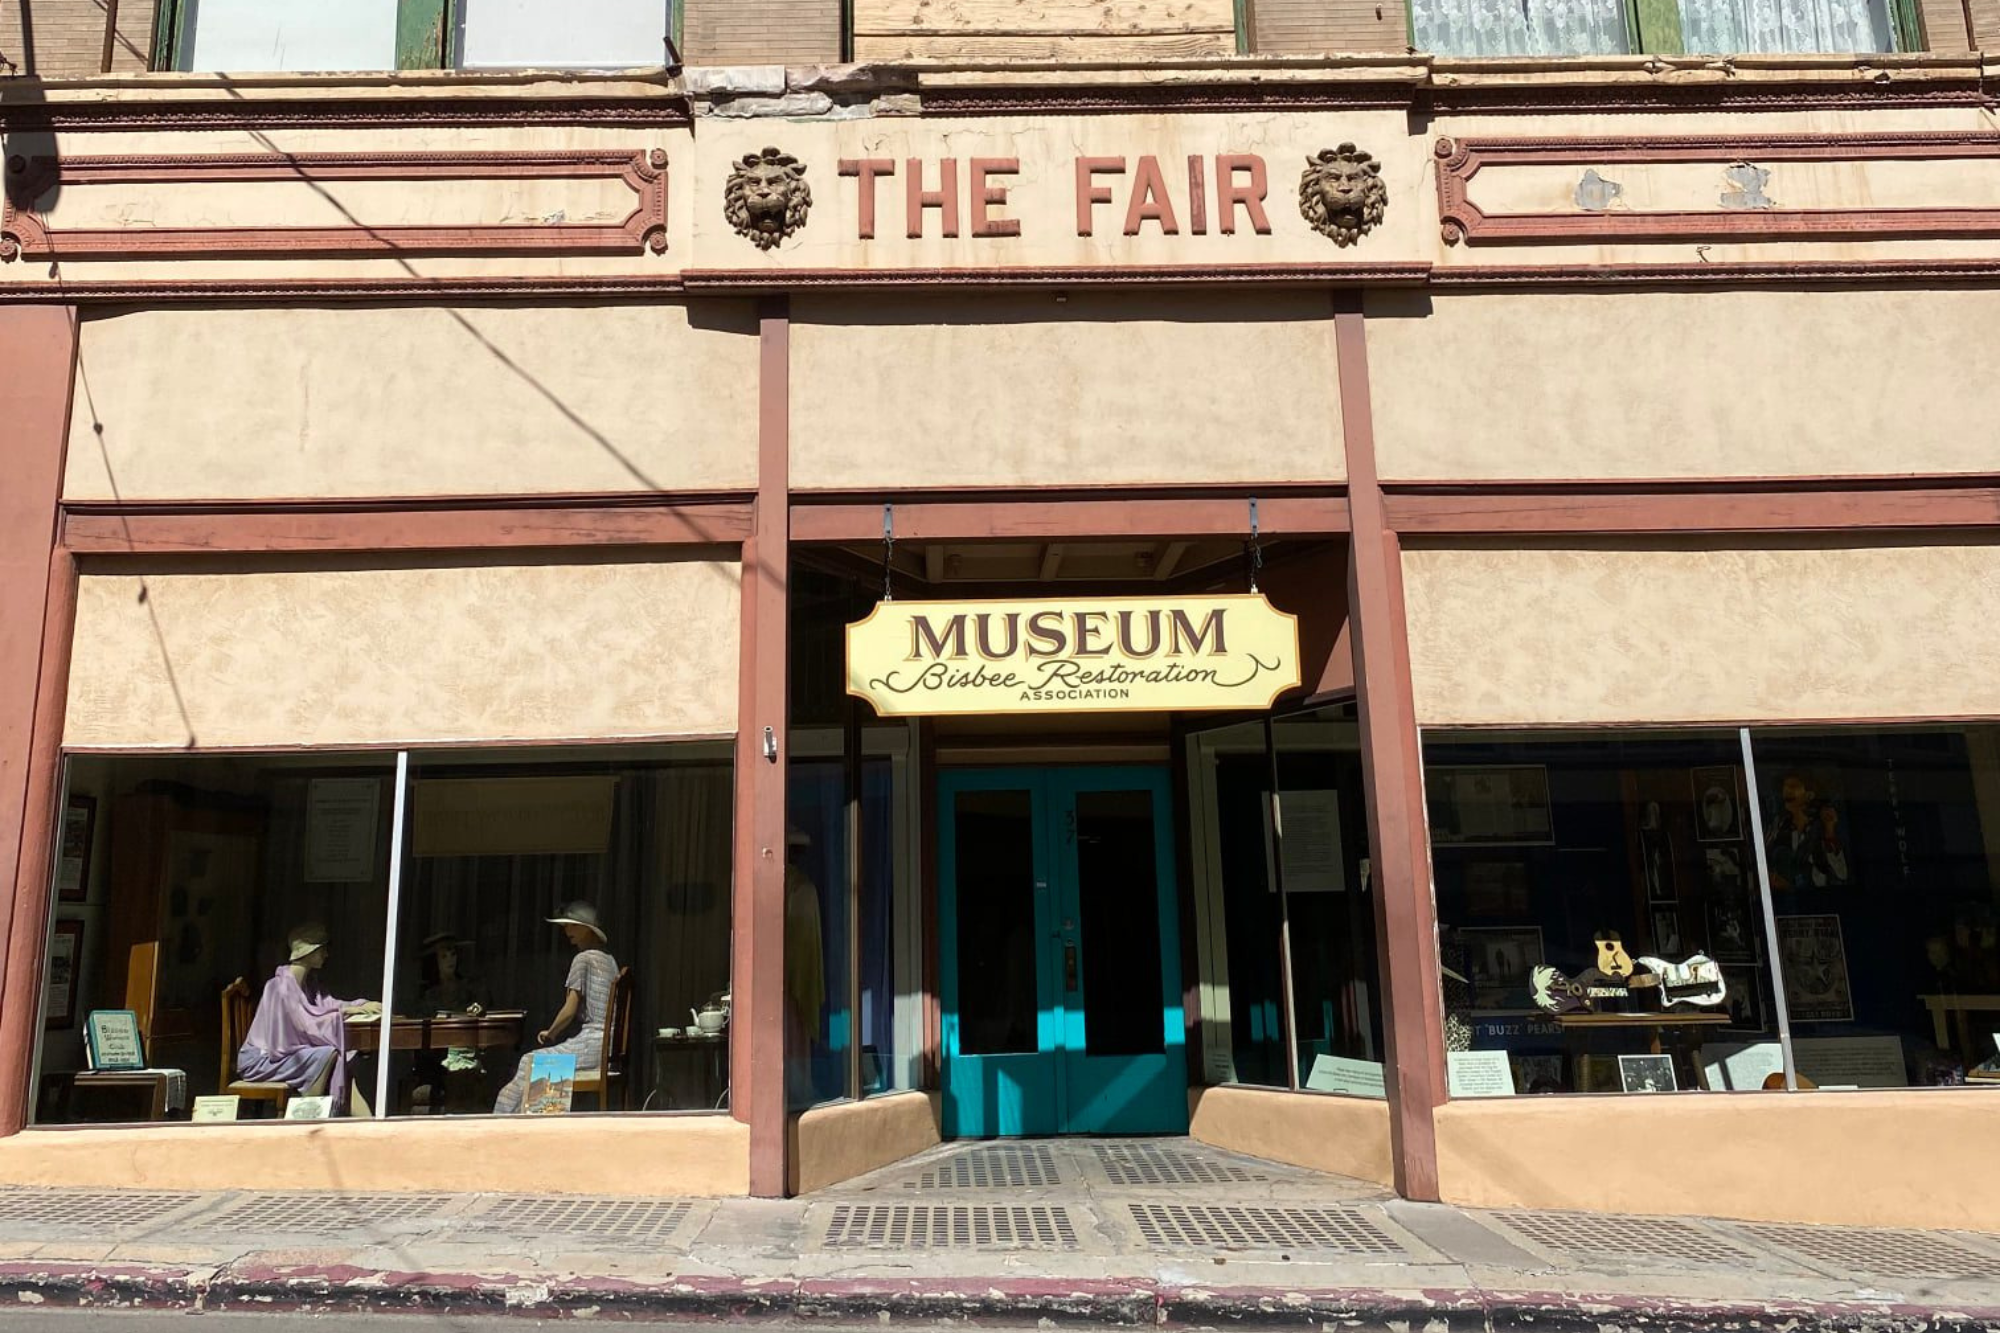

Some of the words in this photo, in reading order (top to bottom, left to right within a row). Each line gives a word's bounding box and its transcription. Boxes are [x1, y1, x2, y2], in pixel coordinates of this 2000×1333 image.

[837, 157, 1021, 239] THE
[1076, 154, 1272, 237] FAIR
[904, 608, 1229, 662] MUSEUM
[870, 663, 1026, 692] Bisbee
[1028, 655, 1281, 691] Restoration
[1020, 687, 1130, 701] ASSOCIATION
[1527, 1024, 1566, 1035] PEARS
